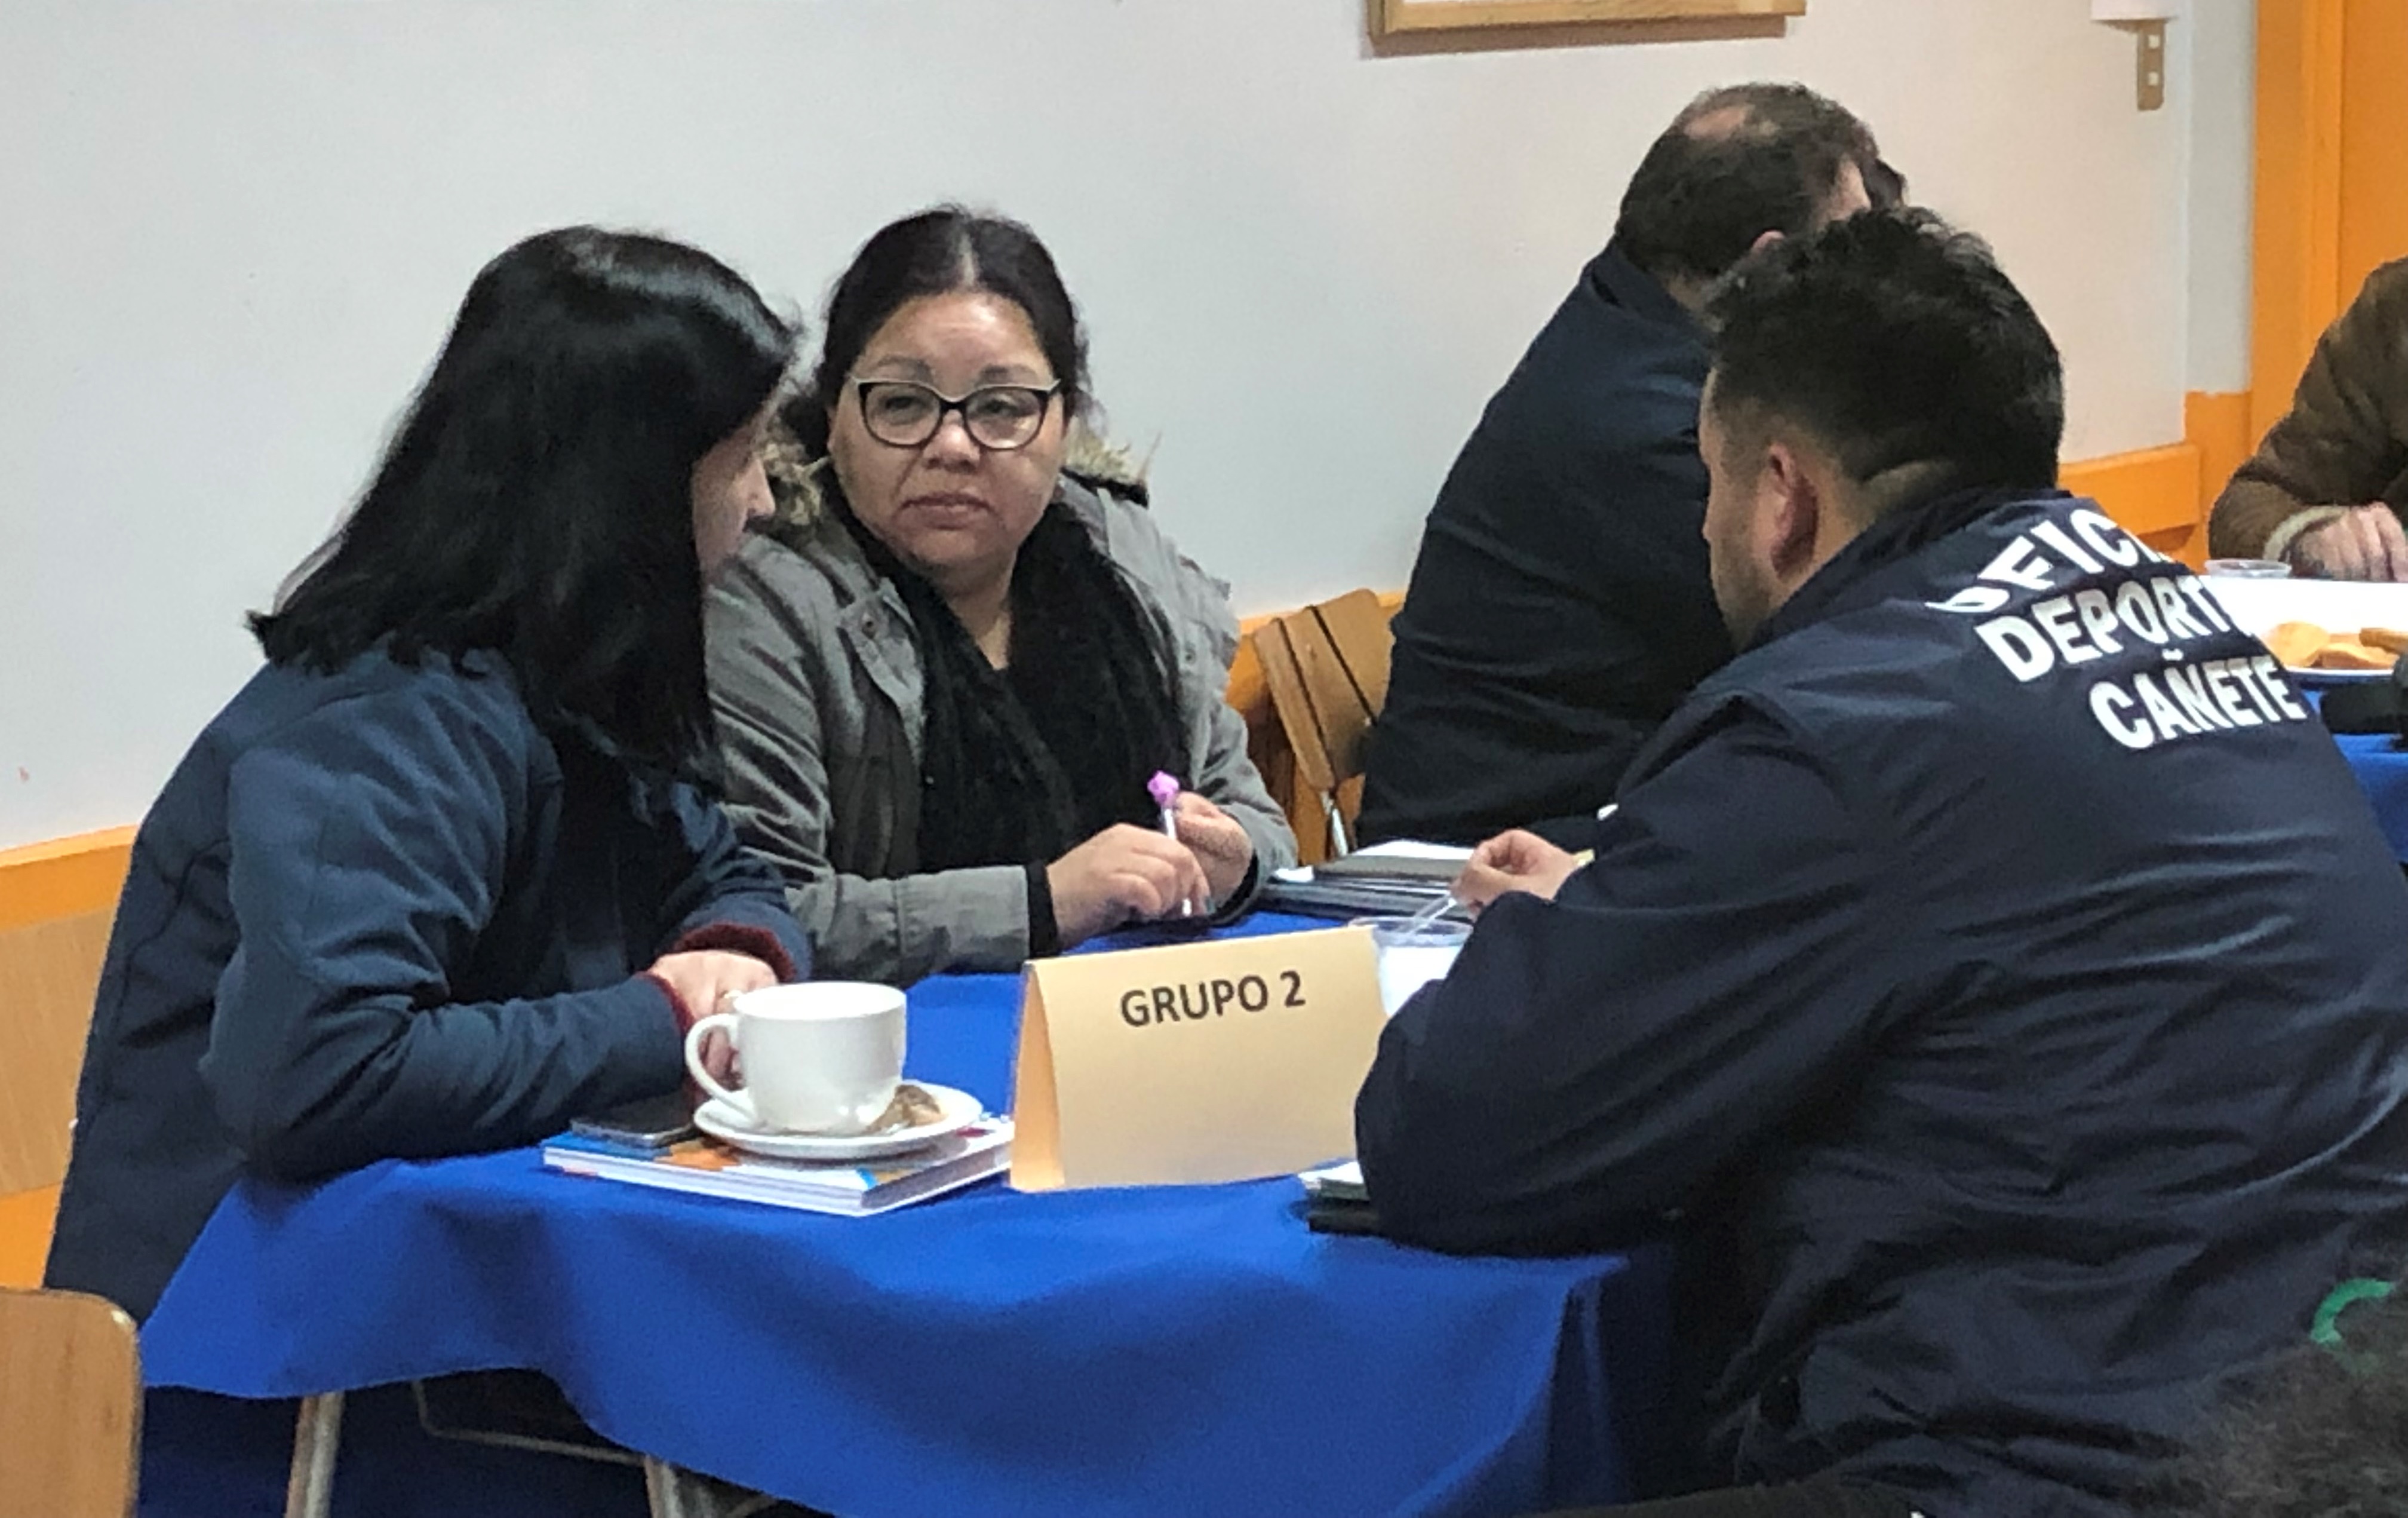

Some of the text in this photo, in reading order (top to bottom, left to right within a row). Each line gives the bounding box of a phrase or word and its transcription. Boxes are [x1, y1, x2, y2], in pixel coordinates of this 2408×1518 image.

[1974, 576, 2249, 682] DEPORT
[2089, 648, 2307, 750] CAÑETE
[1120, 970, 1306, 1027] GRUPO 2
